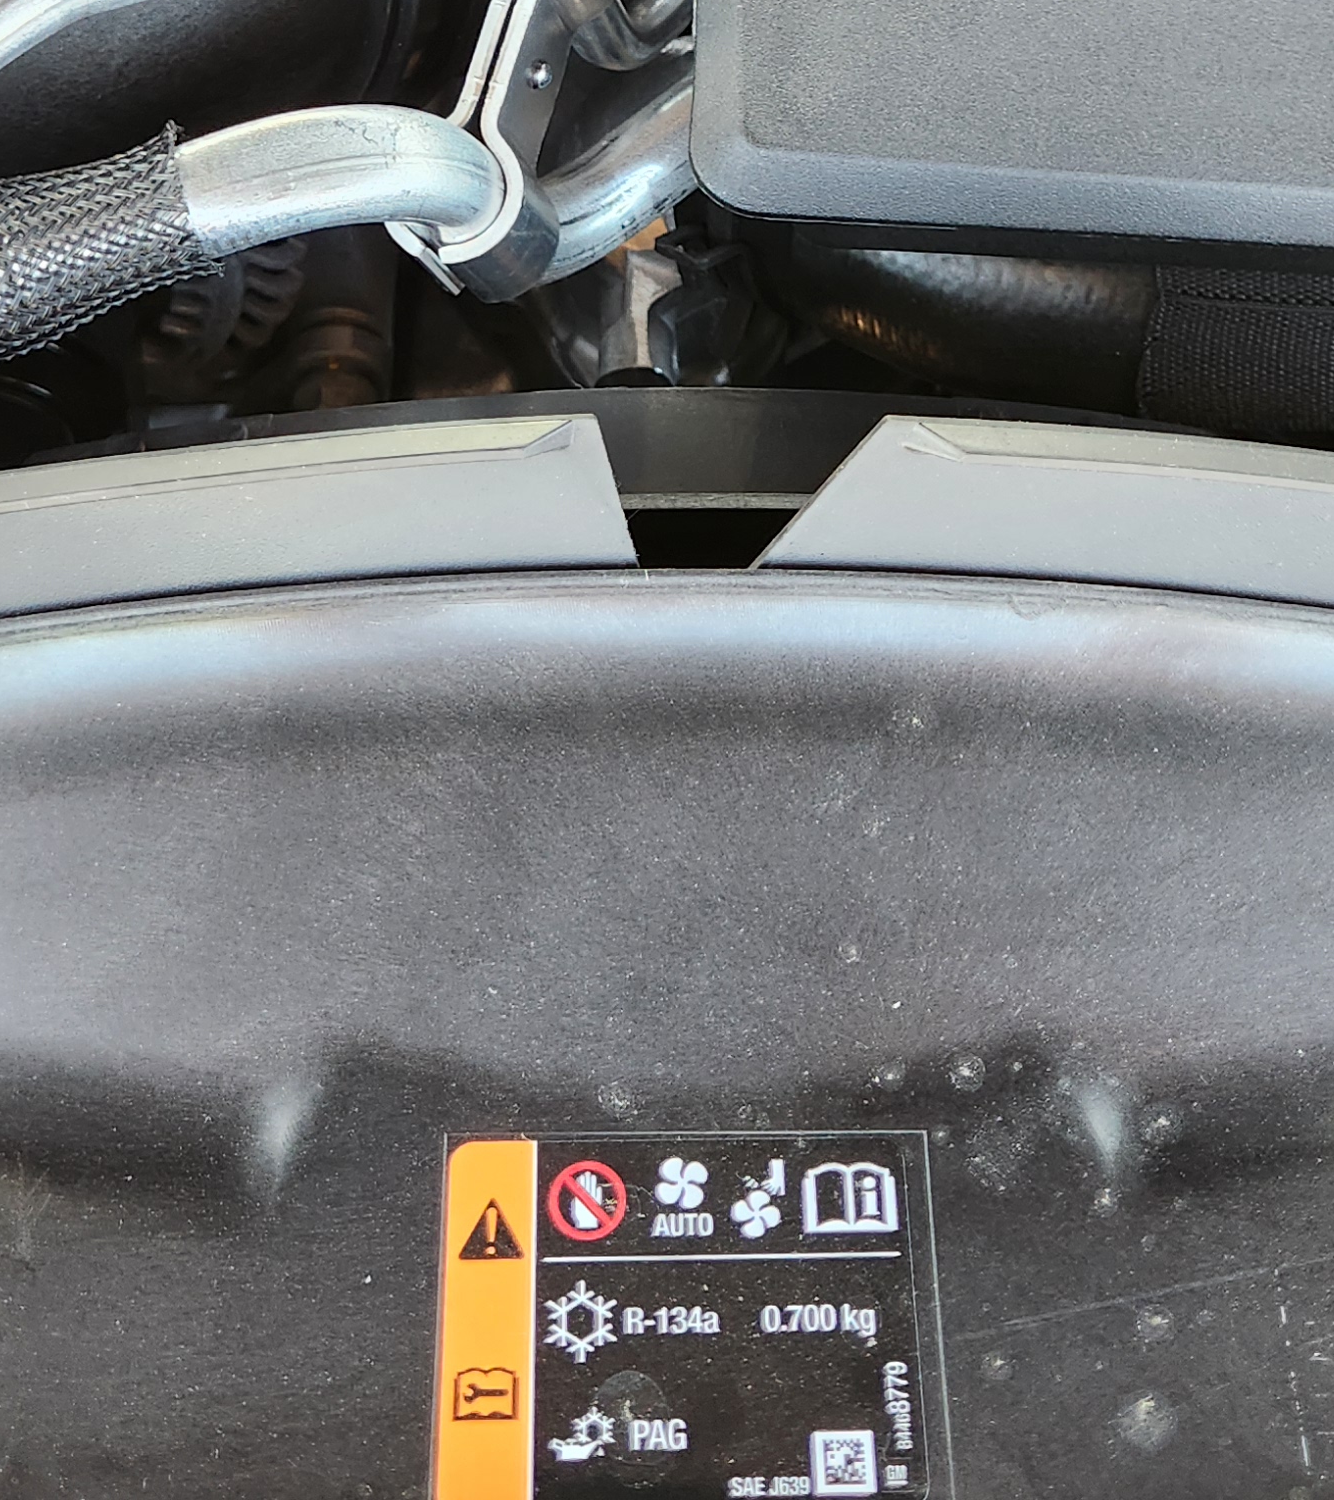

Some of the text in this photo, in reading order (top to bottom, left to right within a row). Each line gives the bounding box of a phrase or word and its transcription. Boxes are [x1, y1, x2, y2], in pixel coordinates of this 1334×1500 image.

[650, 1212, 715, 1238] AUTO
[622, 1303, 877, 1338] R-134a 0.700 kg
[628, 1418, 689, 1452] PAG
[728, 1476, 811, 1498] SAE J639
